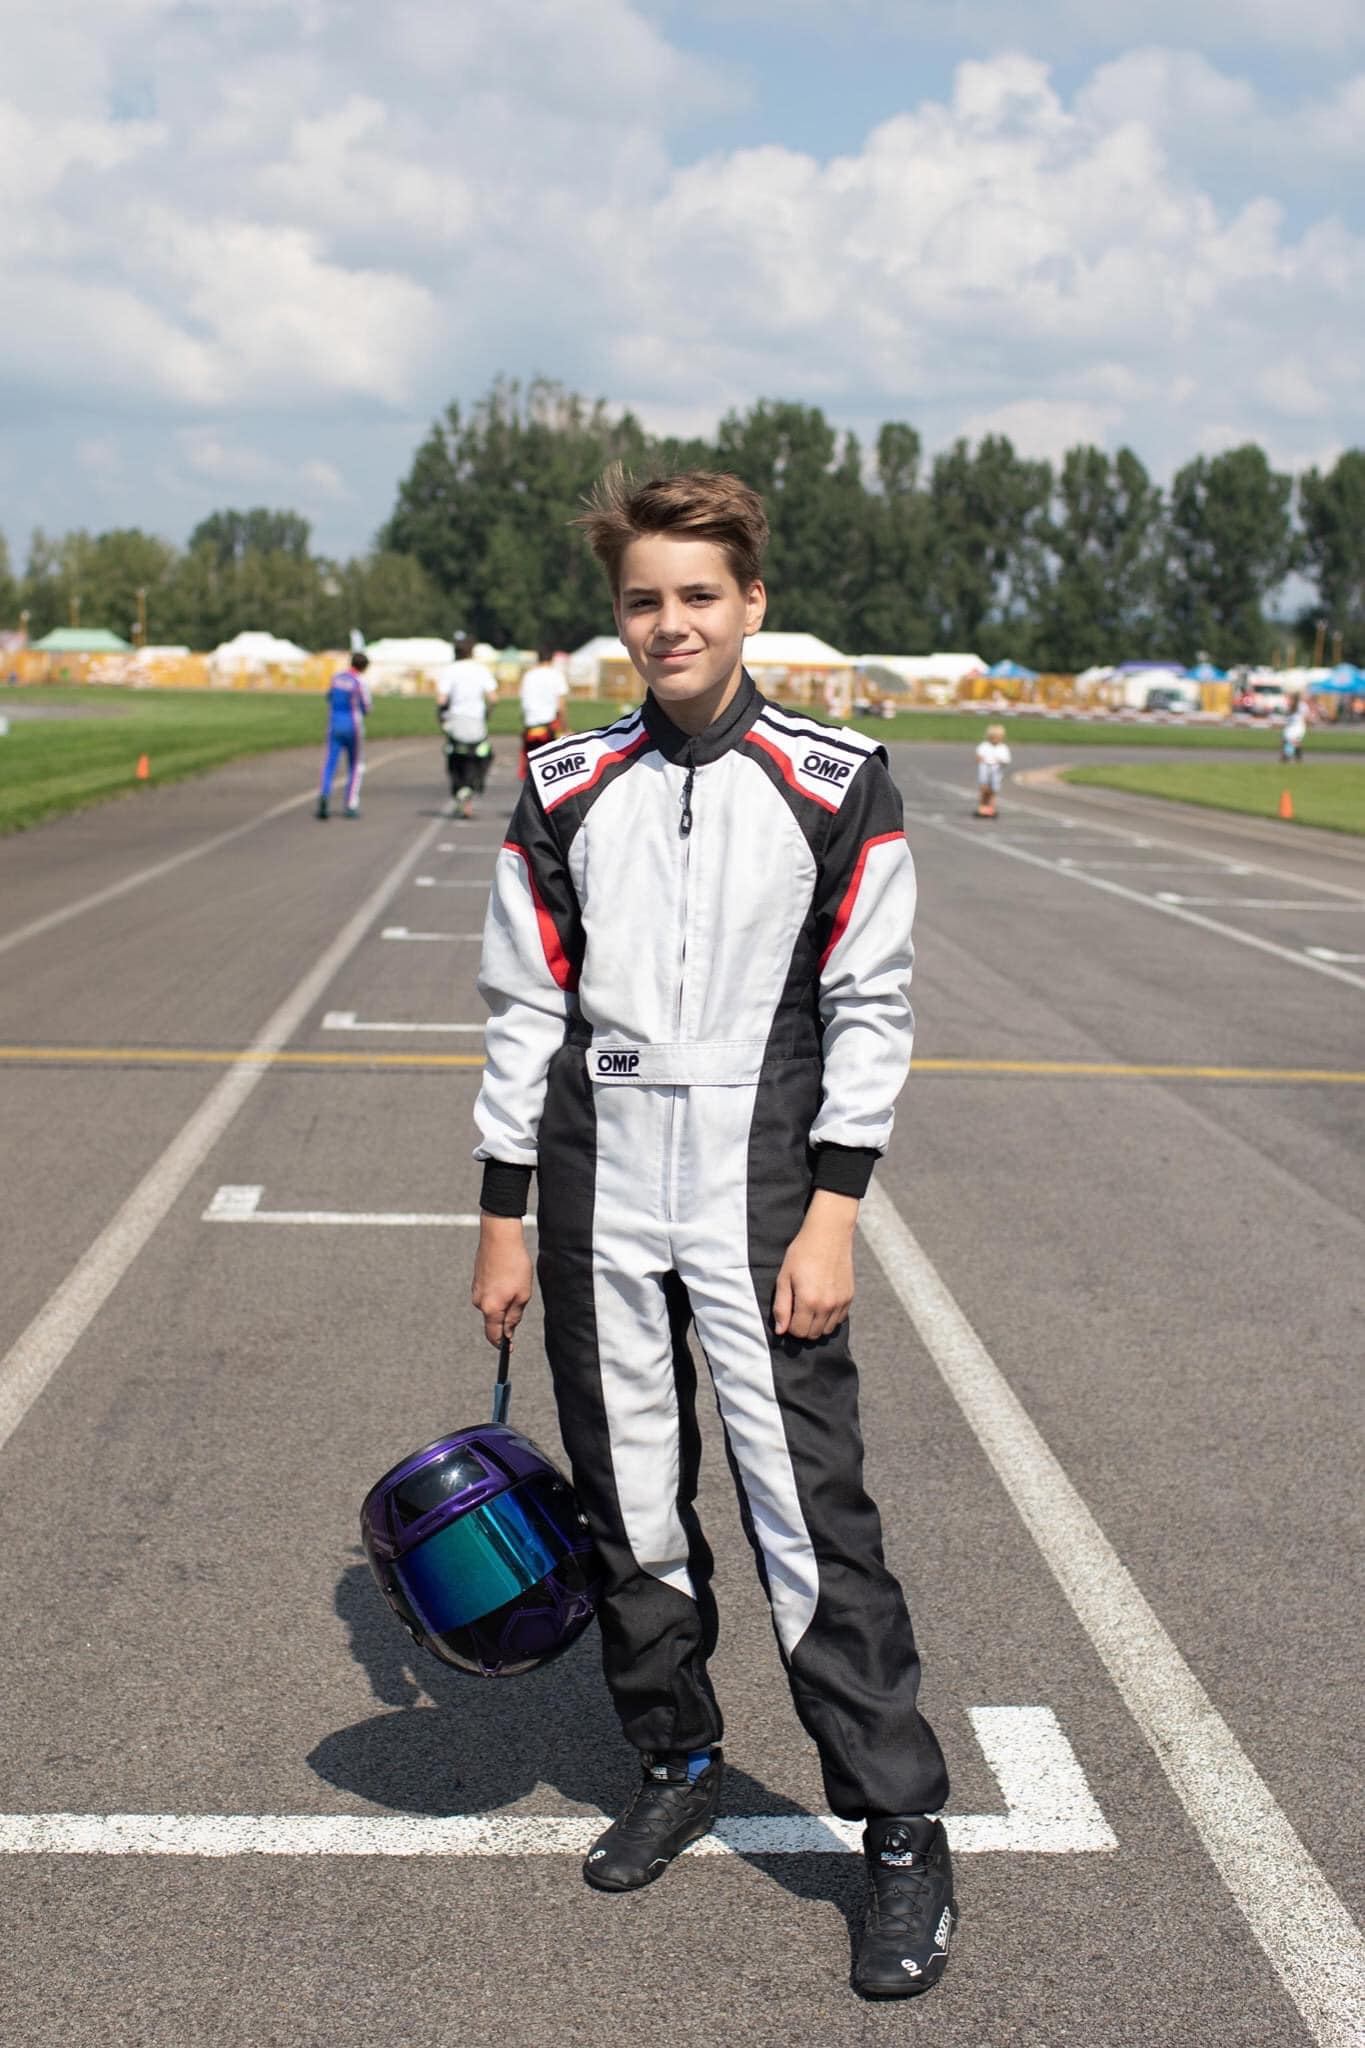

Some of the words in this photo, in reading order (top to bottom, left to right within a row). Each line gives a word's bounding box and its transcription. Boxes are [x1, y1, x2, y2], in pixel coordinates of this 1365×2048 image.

[541, 755, 586, 781] OMP
[803, 755, 850, 780] OMP
[597, 1054, 640, 1072] OMP
